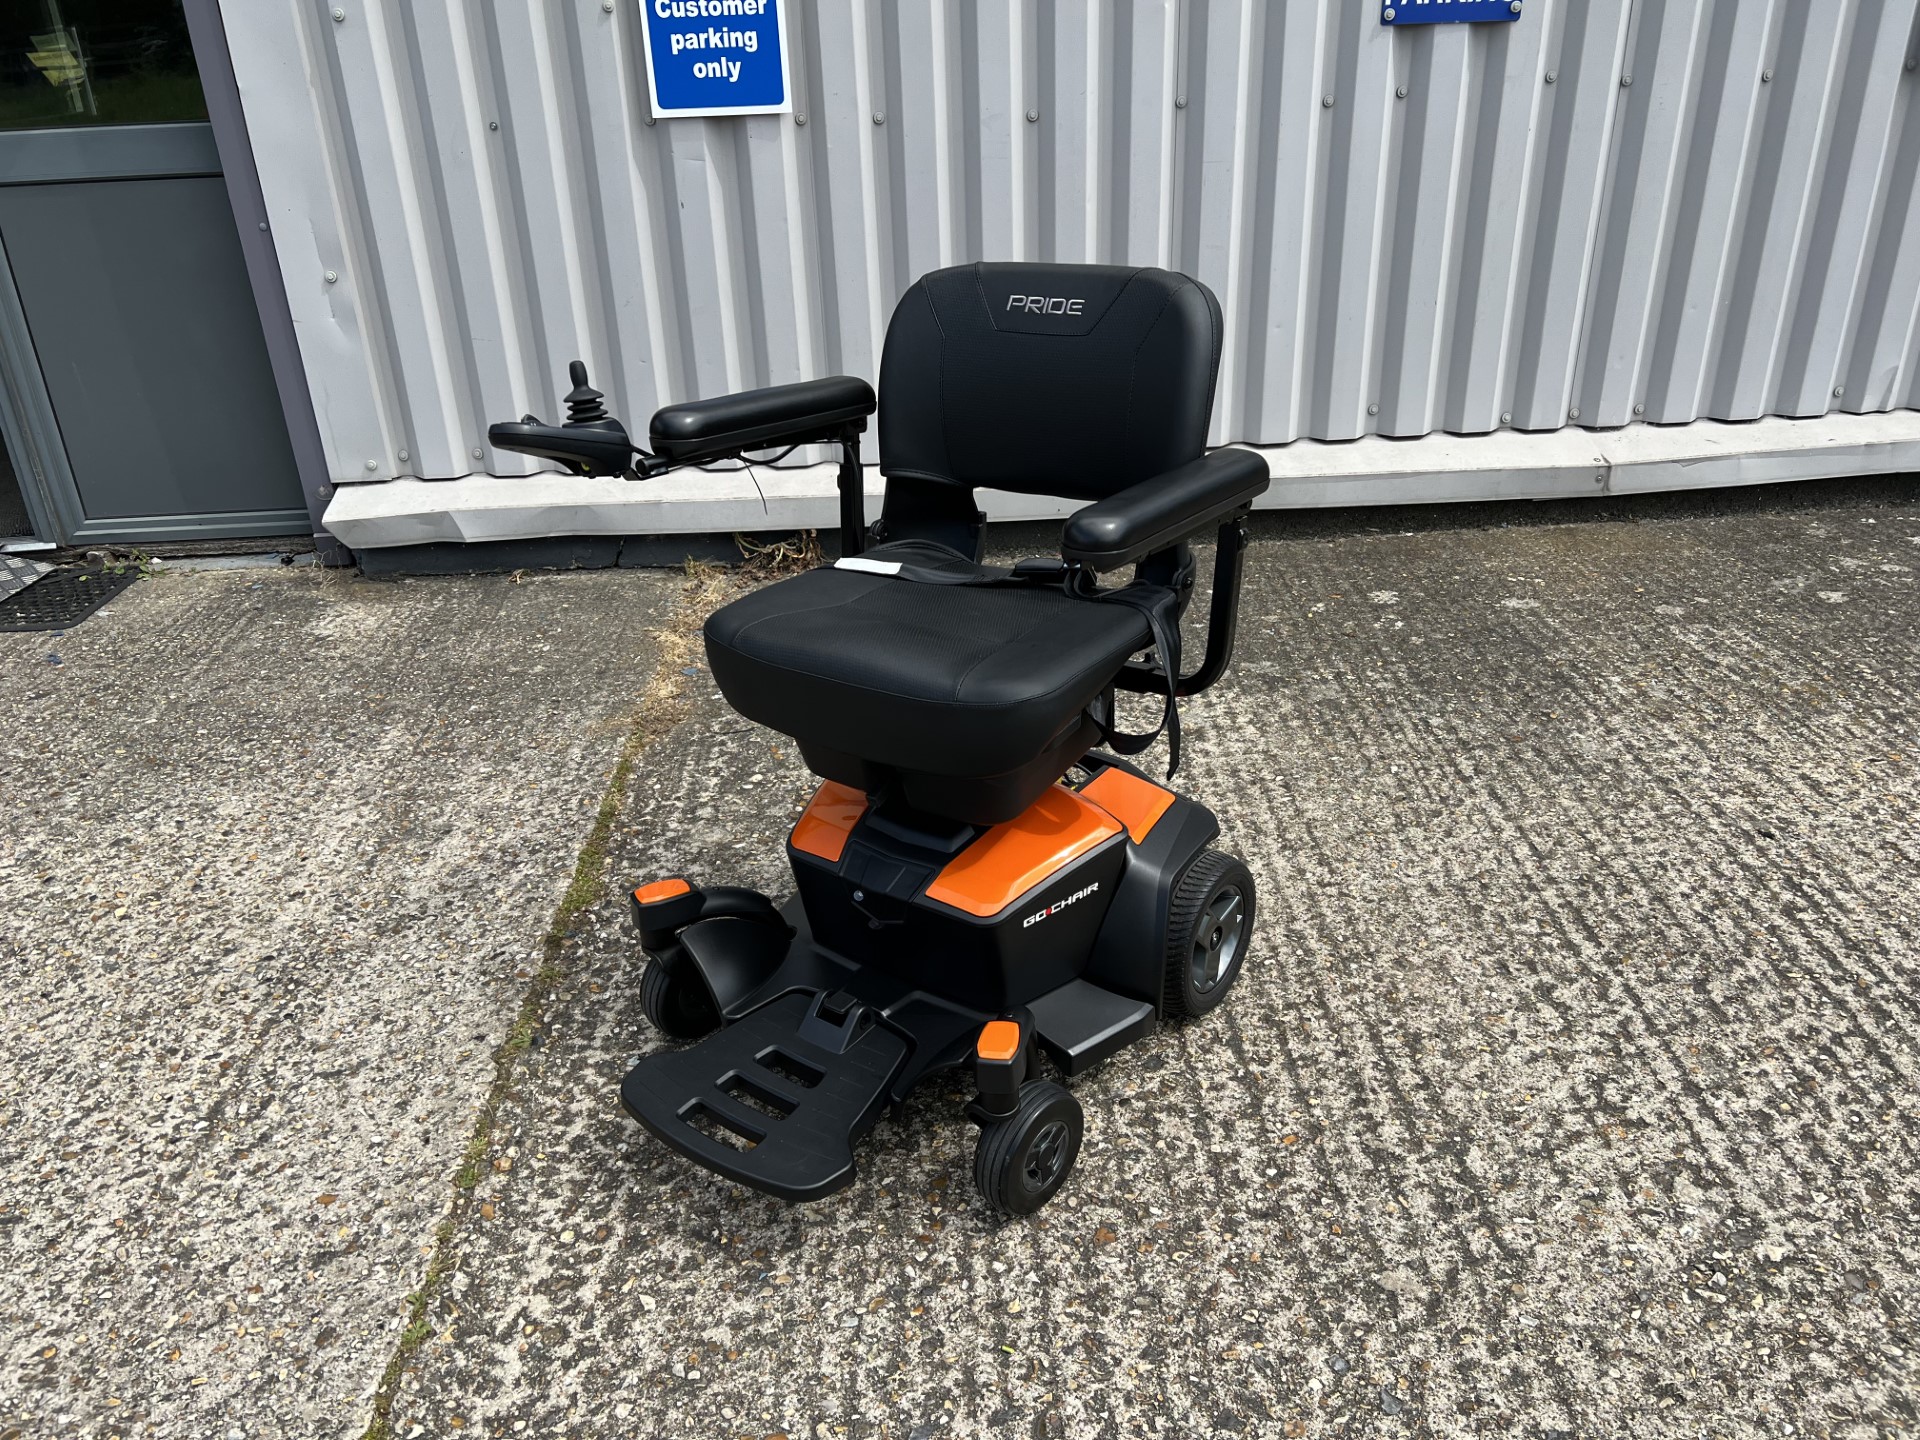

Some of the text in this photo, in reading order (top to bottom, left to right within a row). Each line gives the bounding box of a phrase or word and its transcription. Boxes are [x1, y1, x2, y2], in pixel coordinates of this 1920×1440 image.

[654, 0, 767, 18] Customer
[670, 27, 758, 55] parking
[693, 57, 741, 82] only
[1006, 294, 1085, 315] PRIDE
